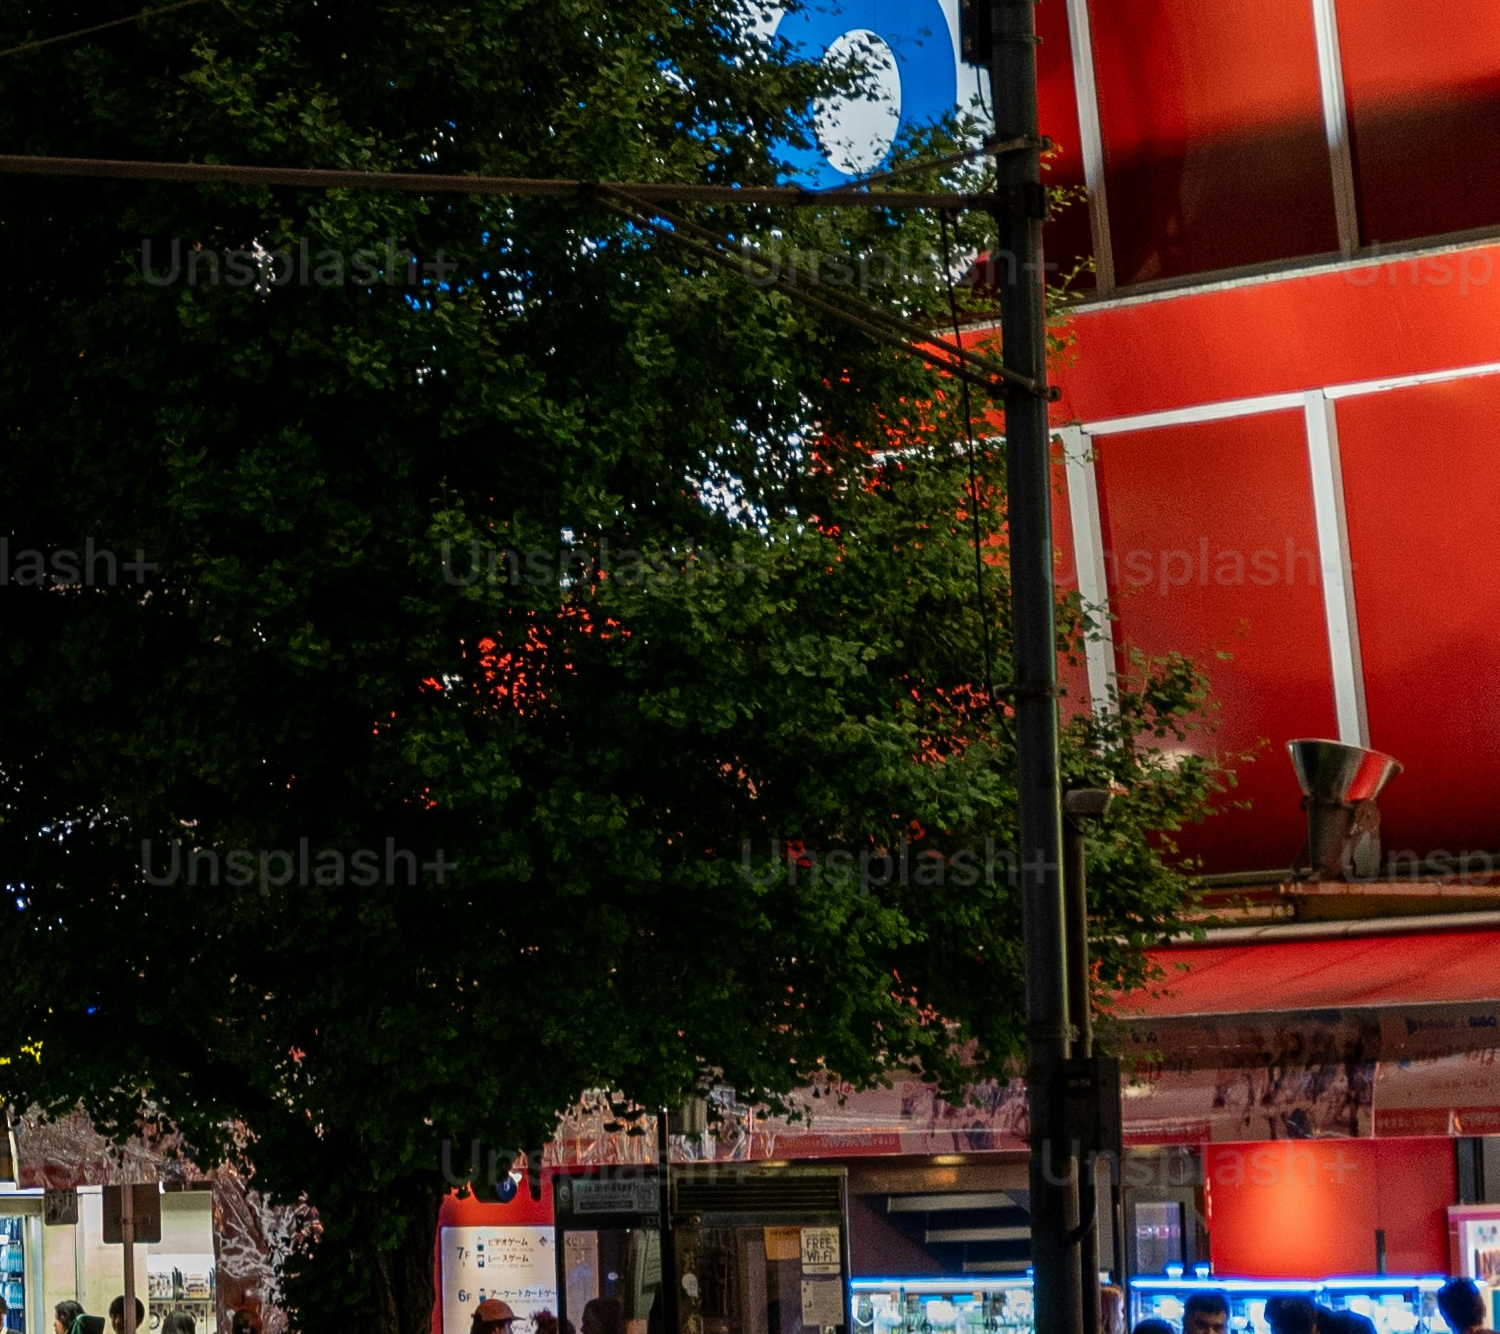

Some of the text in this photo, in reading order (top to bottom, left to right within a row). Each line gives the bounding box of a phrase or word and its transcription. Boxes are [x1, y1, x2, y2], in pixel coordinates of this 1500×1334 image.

[805, 1238, 832, 1250] FREE
[457, 1245, 470, 1259] 7F
[805, 1250, 832, 1262] Wi-Fi
[458, 1289, 472, 1303] 6F
